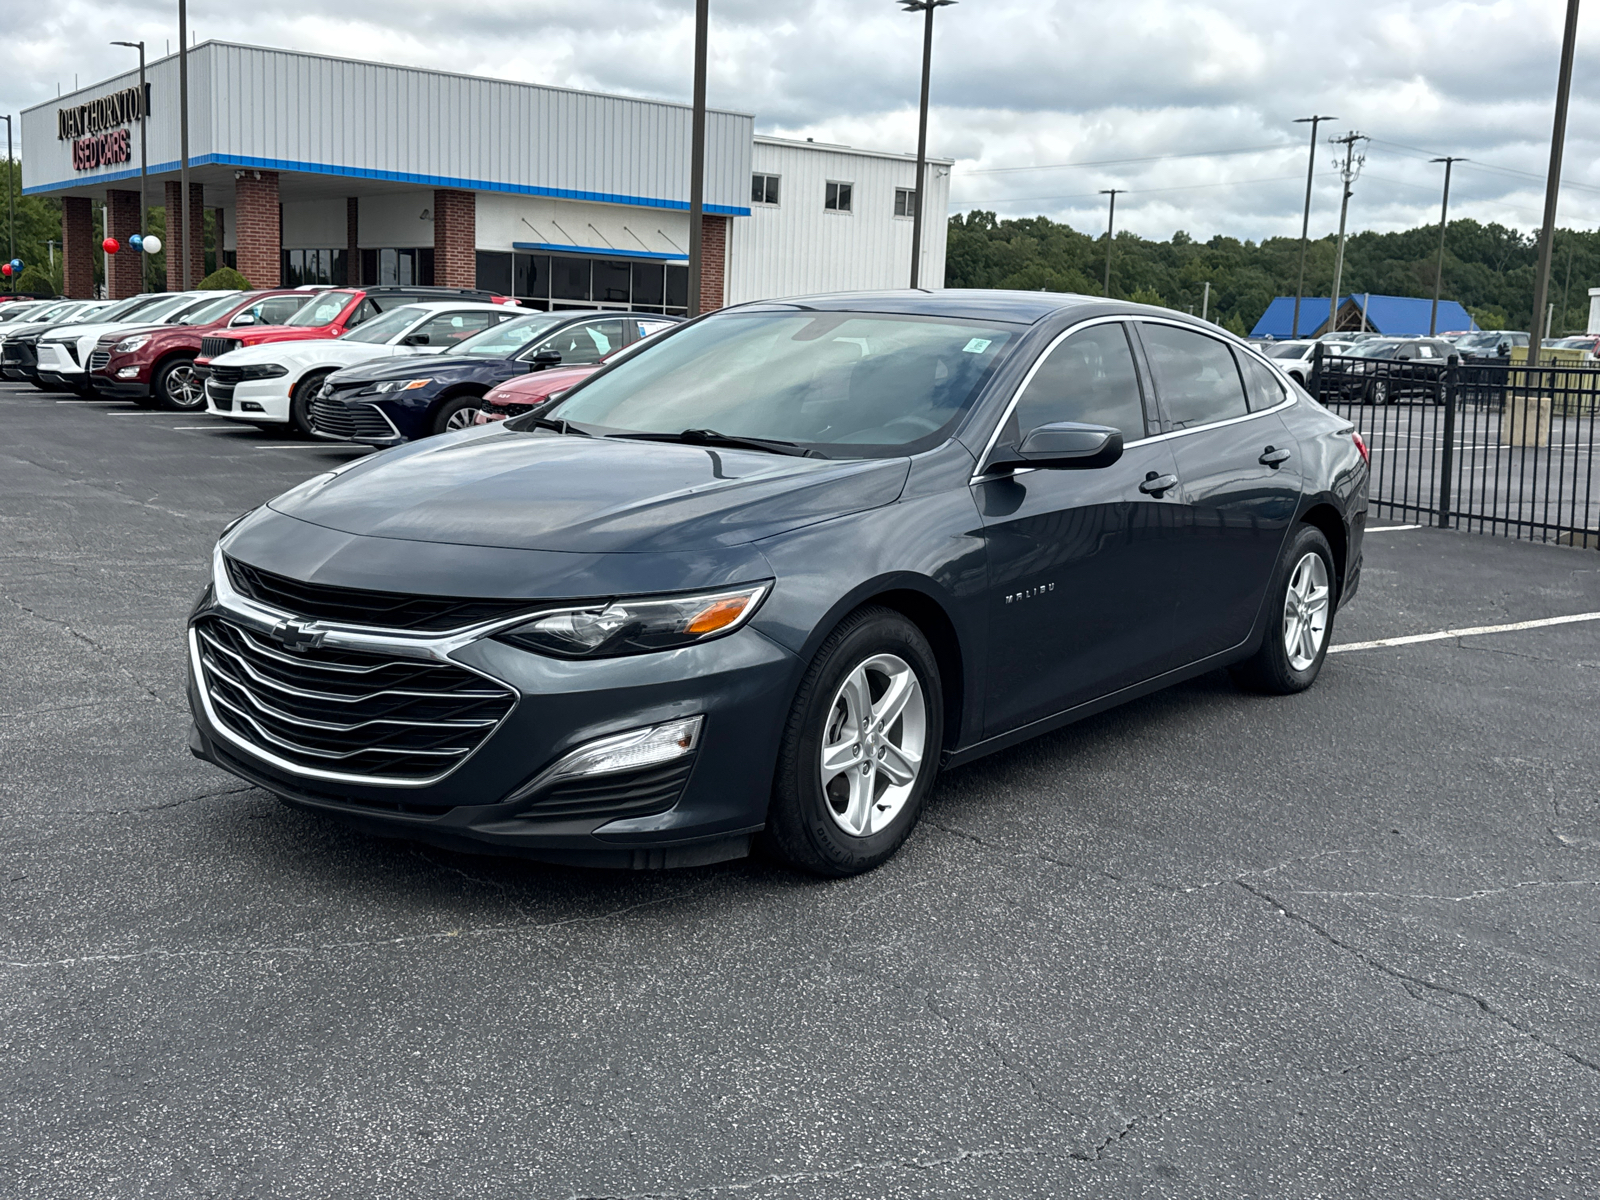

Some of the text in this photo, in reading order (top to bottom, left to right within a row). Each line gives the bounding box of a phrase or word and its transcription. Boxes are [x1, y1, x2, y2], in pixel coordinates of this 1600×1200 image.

[57, 105, 85, 140] JOHN
[72, 128, 131, 170] USED CARS
[1005, 582, 1055, 604] MALIBU
